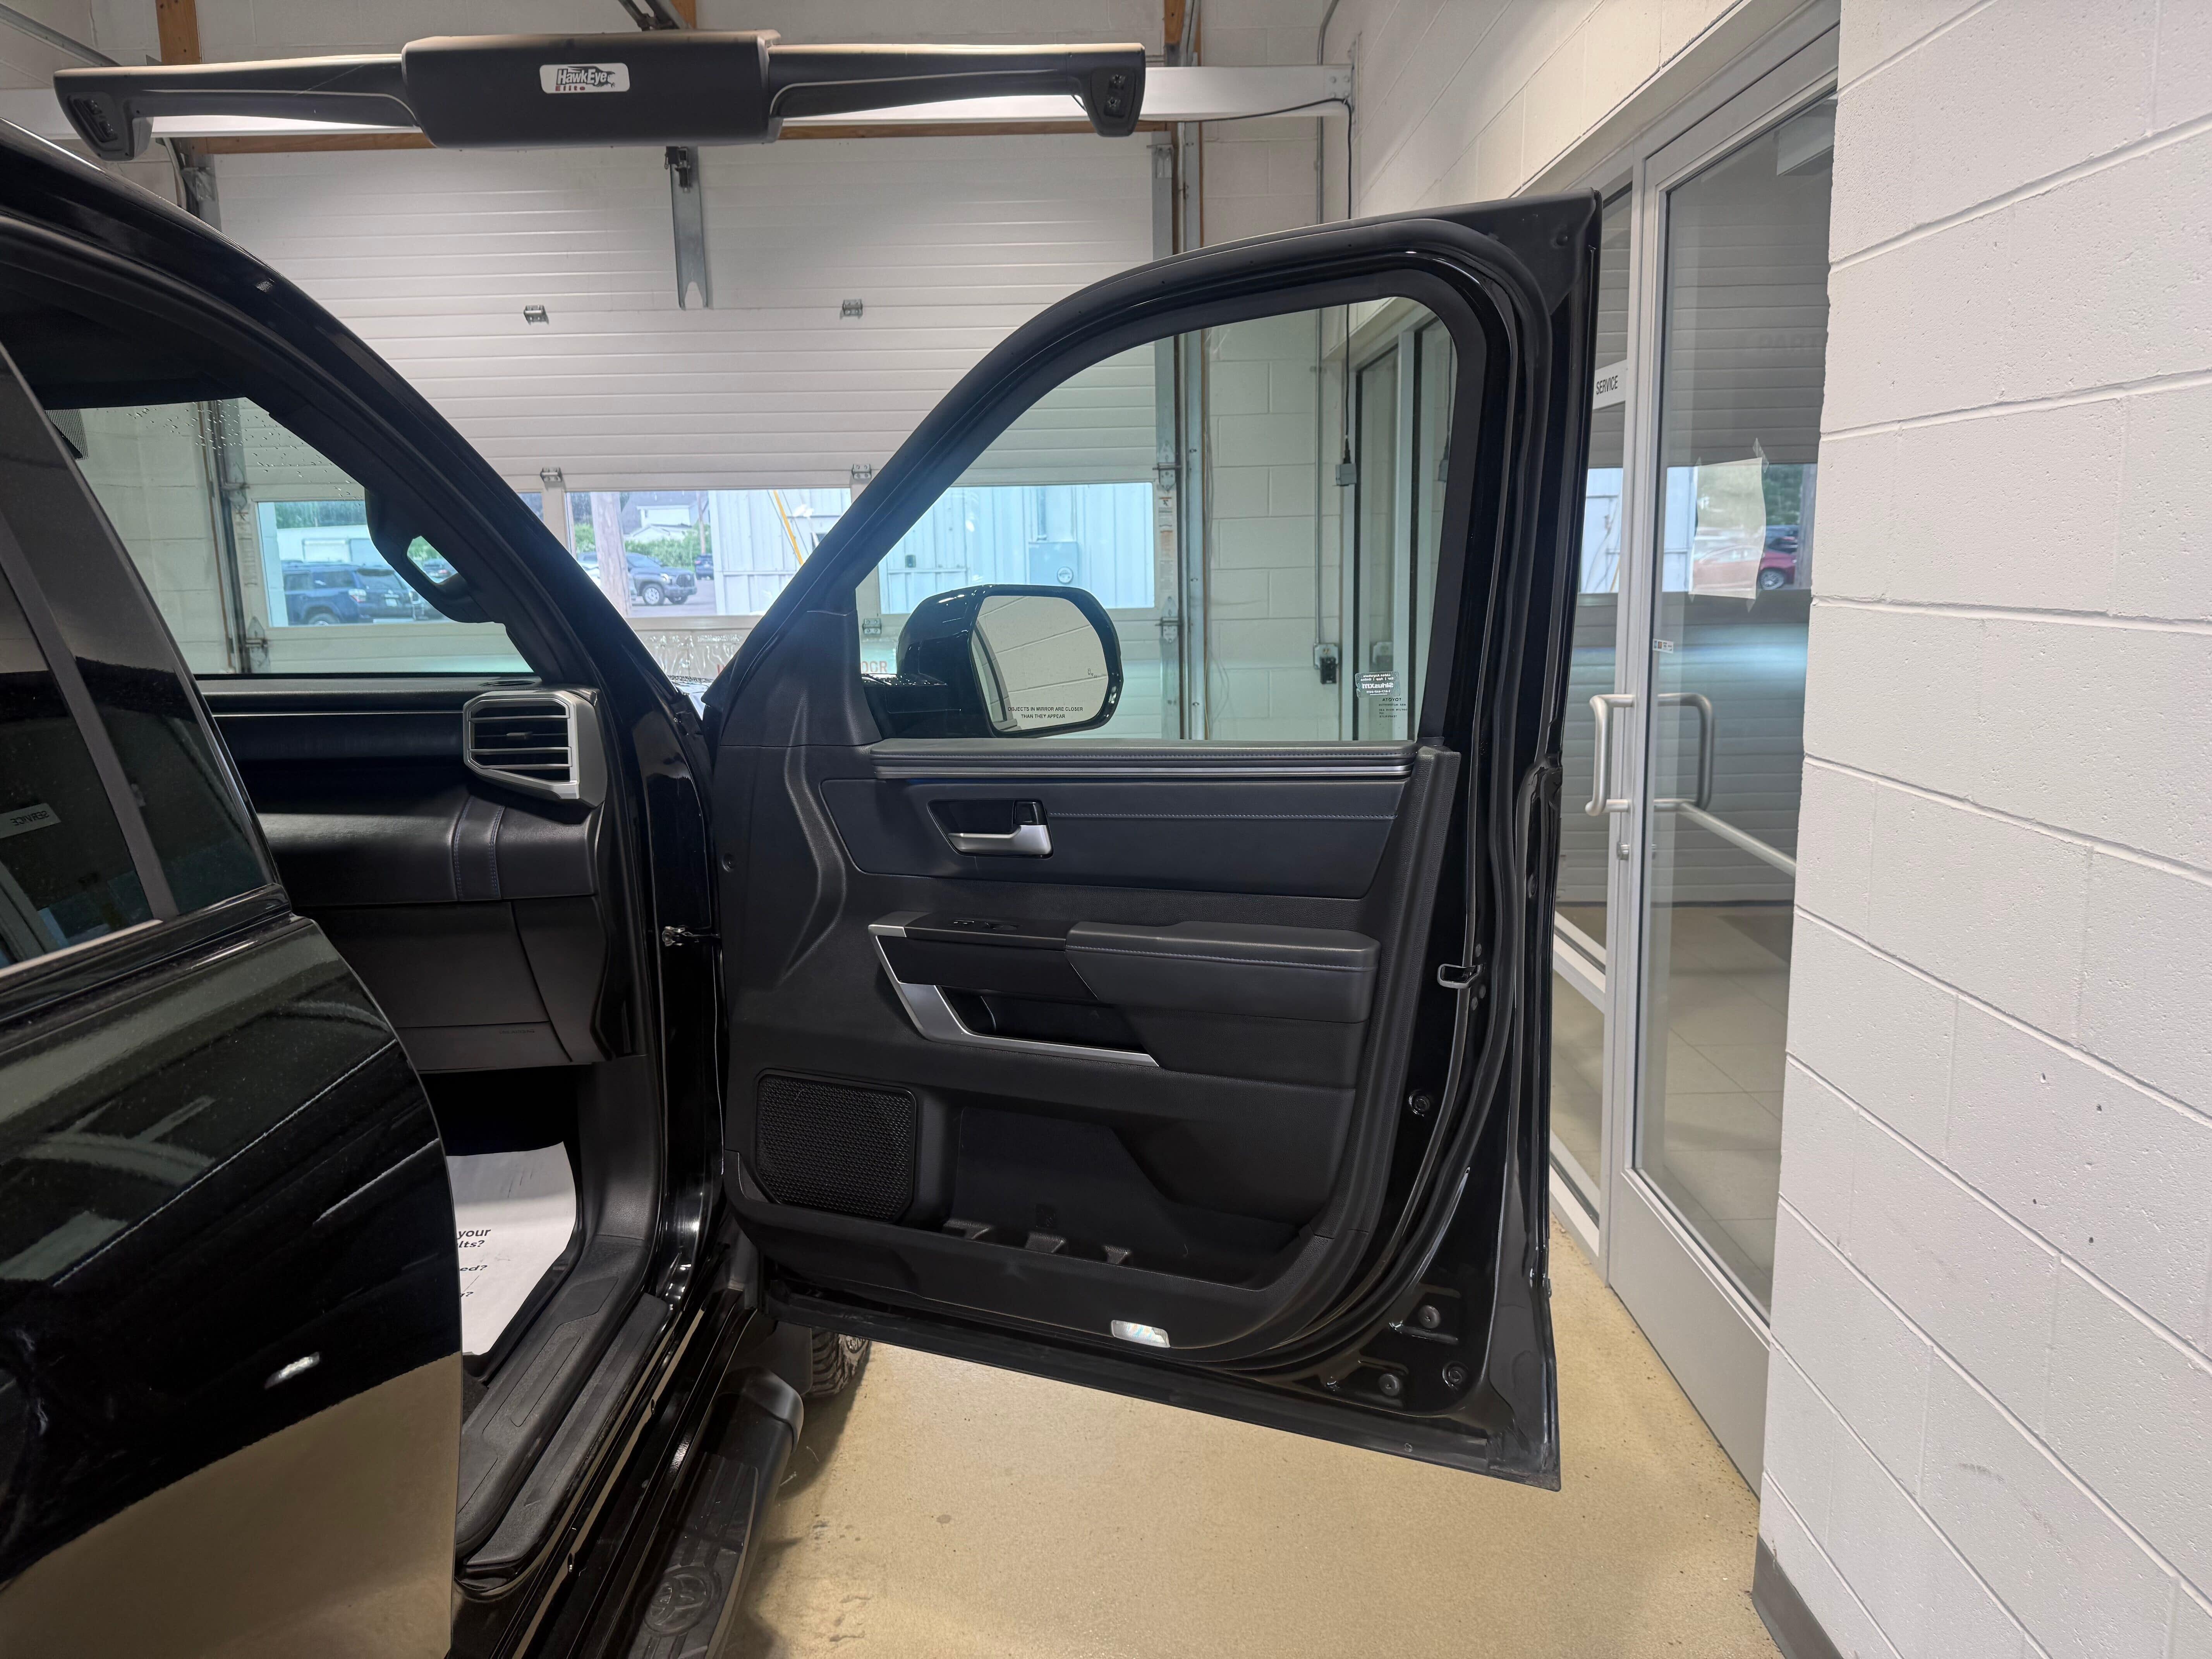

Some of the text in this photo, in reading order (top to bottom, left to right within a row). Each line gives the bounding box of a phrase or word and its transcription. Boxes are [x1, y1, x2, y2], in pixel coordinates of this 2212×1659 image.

[556, 68, 607, 85] HawkEye
[1596, 375, 1618, 395] SERVICE
[457, 1229, 491, 1240] your
